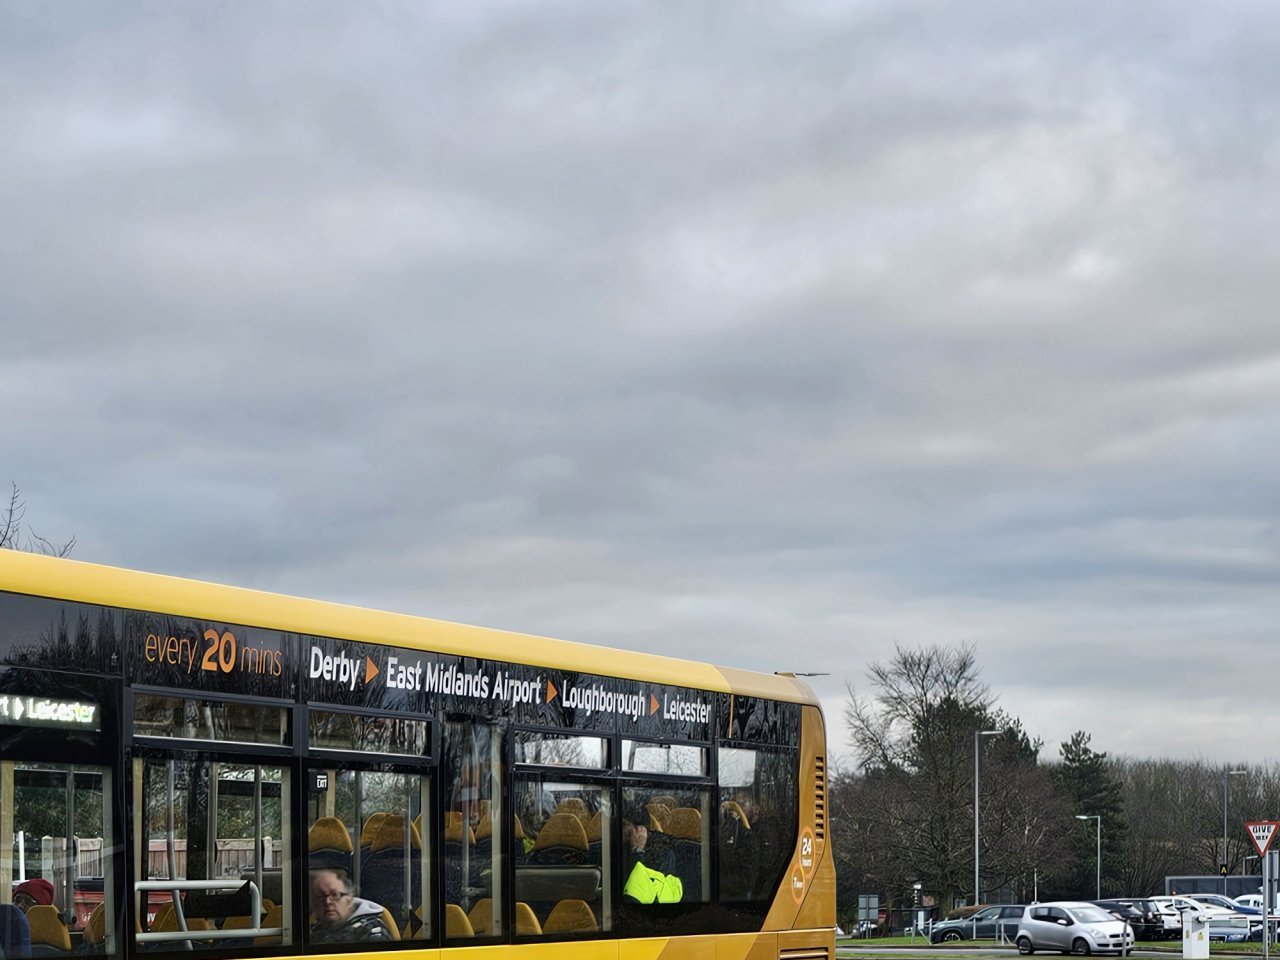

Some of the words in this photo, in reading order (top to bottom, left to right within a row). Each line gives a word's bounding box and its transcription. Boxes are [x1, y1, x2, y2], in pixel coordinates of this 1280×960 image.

[145, 633, 198, 674] every
[201, 629, 237, 674] 20
[240, 640, 282, 677] mins
[310, 646, 361, 691] Derby
[386, 657, 422, 691] East
[426, 662, 489, 698] Midlands
[492, 671, 542, 708] Airport
[562, 680, 646, 721] Loughborough
[663, 693, 712, 724] Leicester
[26, 698, 95, 723] Leicester
[1252, 825, 1271, 833] GIVE
[802, 837, 812, 855] 24
